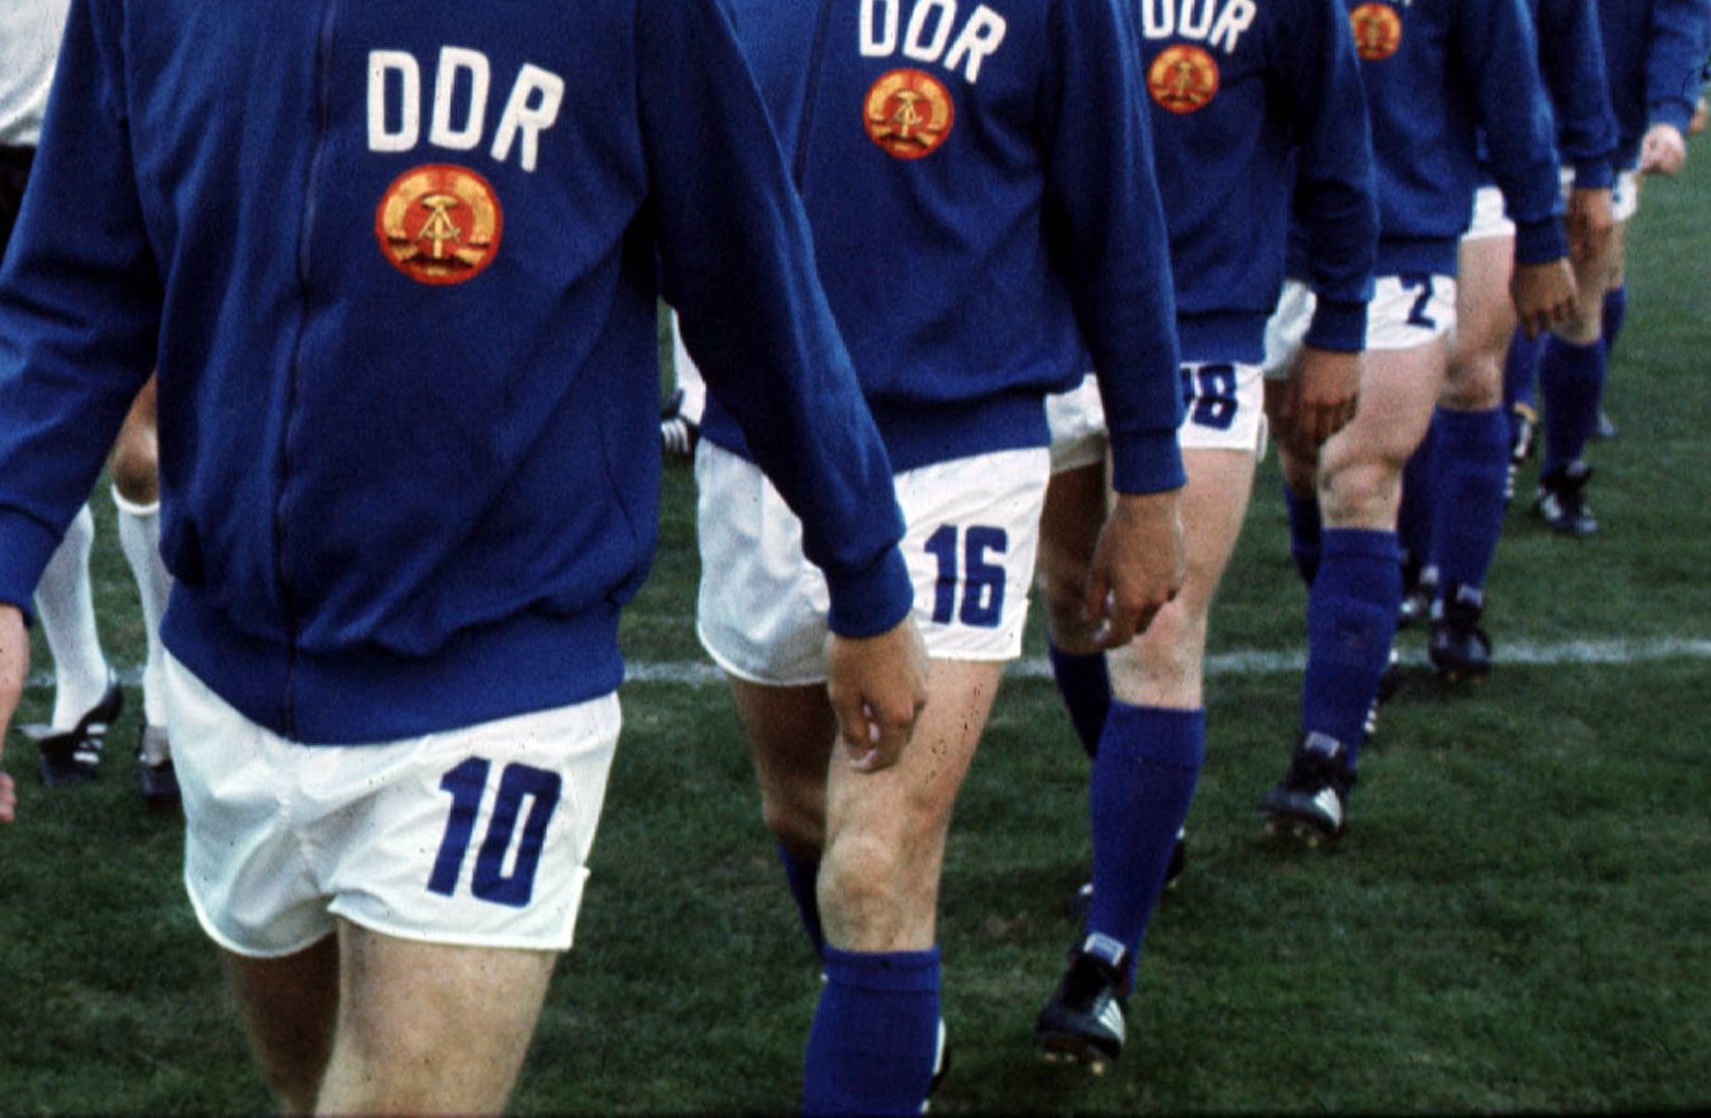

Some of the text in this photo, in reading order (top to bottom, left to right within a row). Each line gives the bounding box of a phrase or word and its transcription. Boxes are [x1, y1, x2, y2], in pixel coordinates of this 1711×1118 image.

[367, 46, 565, 173] DDR
[1400, 274, 1436, 330] 2
[923, 524, 1008, 628] 16
[427, 756, 562, 908] 10
